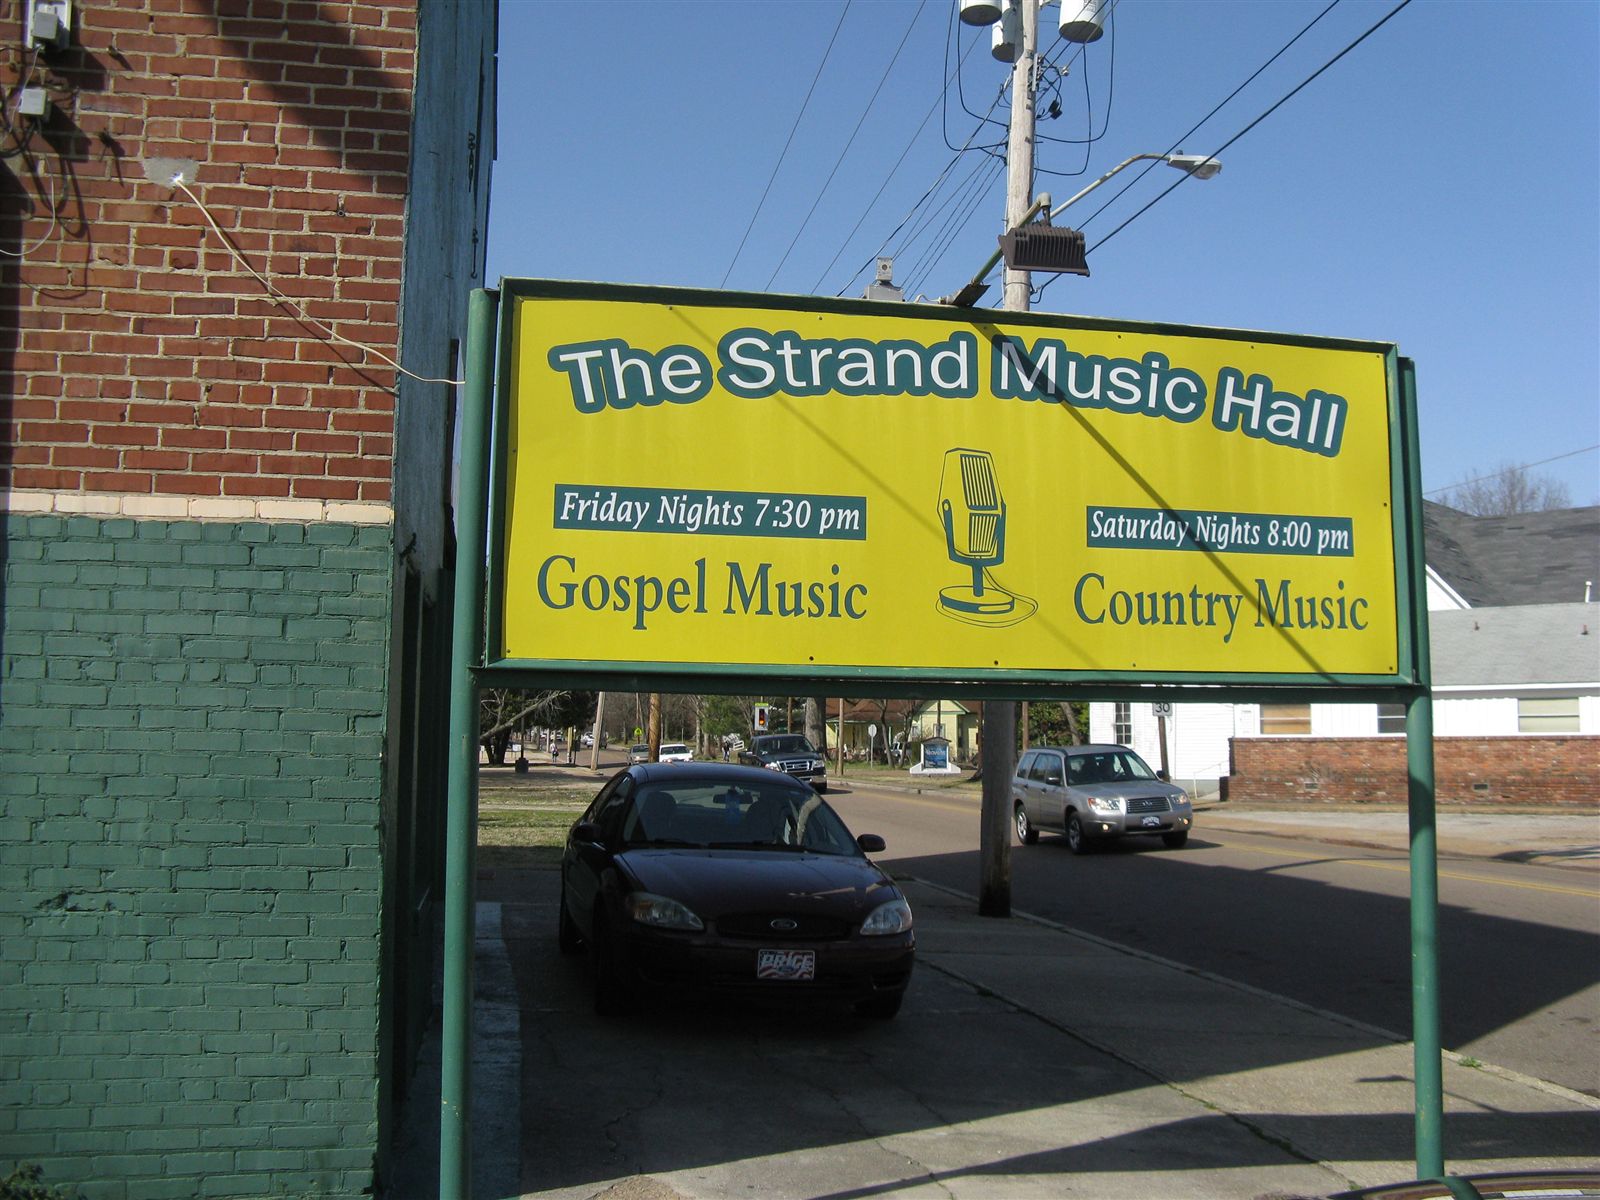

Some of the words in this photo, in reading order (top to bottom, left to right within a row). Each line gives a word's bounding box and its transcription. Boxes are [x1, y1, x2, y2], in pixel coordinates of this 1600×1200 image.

[556, 345, 704, 406] The
[726, 335, 970, 391] Strand
[998, 340, 1200, 415] Music
[1219, 374, 1341, 450] Hall
[560, 491, 650, 530] Friday
[657, 495, 744, 532] Nights
[755, 499, 812, 529] 7:30
[819, 508, 860, 535] pm
[1091, 511, 1190, 548] Saturday
[1195, 515, 1261, 550] Nights
[1268, 520, 1312, 548] 8:00
[1318, 529, 1349, 555] pm
[538, 555, 708, 631] Gospel
[724, 562, 868, 620] Music
[1074, 573, 1243, 643] Country
[1254, 579, 1369, 631] Music
[1155, 702, 1170, 713] 30
[760, 952, 813, 970] PRICE
